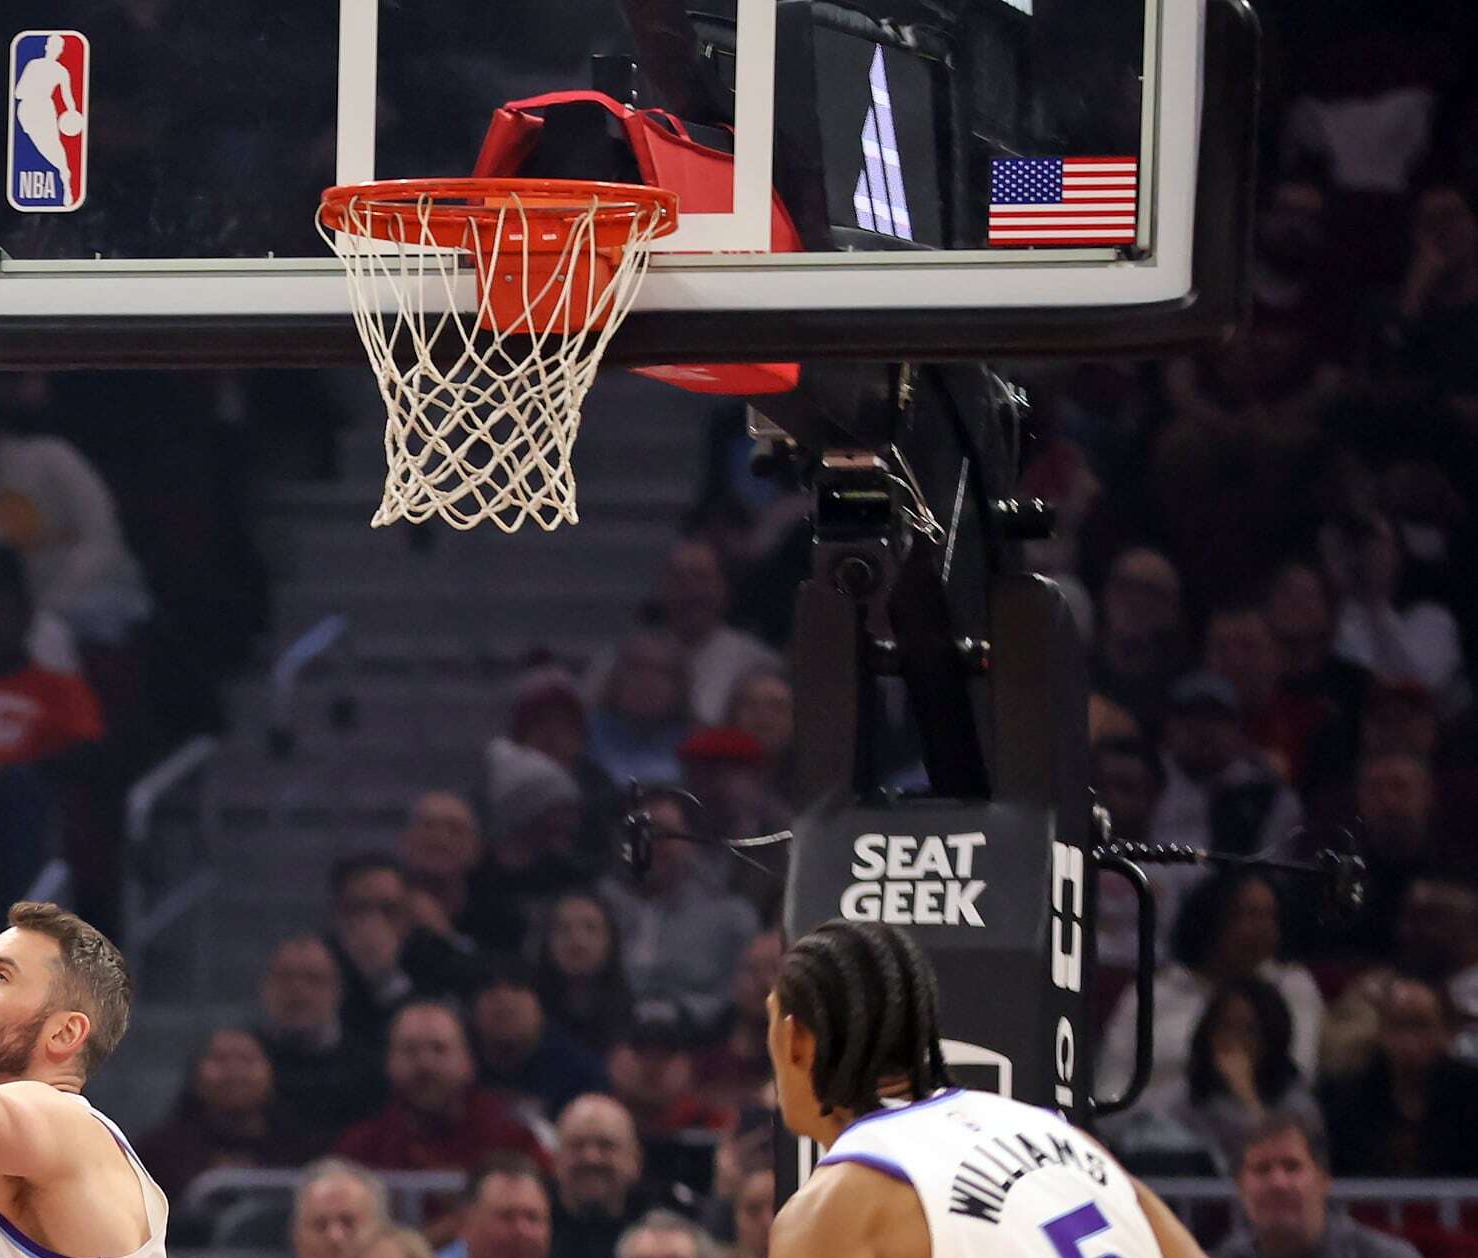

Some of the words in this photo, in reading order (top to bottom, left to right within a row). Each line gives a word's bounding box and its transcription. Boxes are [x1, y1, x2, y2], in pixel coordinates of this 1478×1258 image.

[19, 171, 56, 198] NBA
[851, 831, 987, 880] SEAT
[839, 880, 987, 927] GEEK
[949, 1132, 1108, 1225] WILLIAMS
